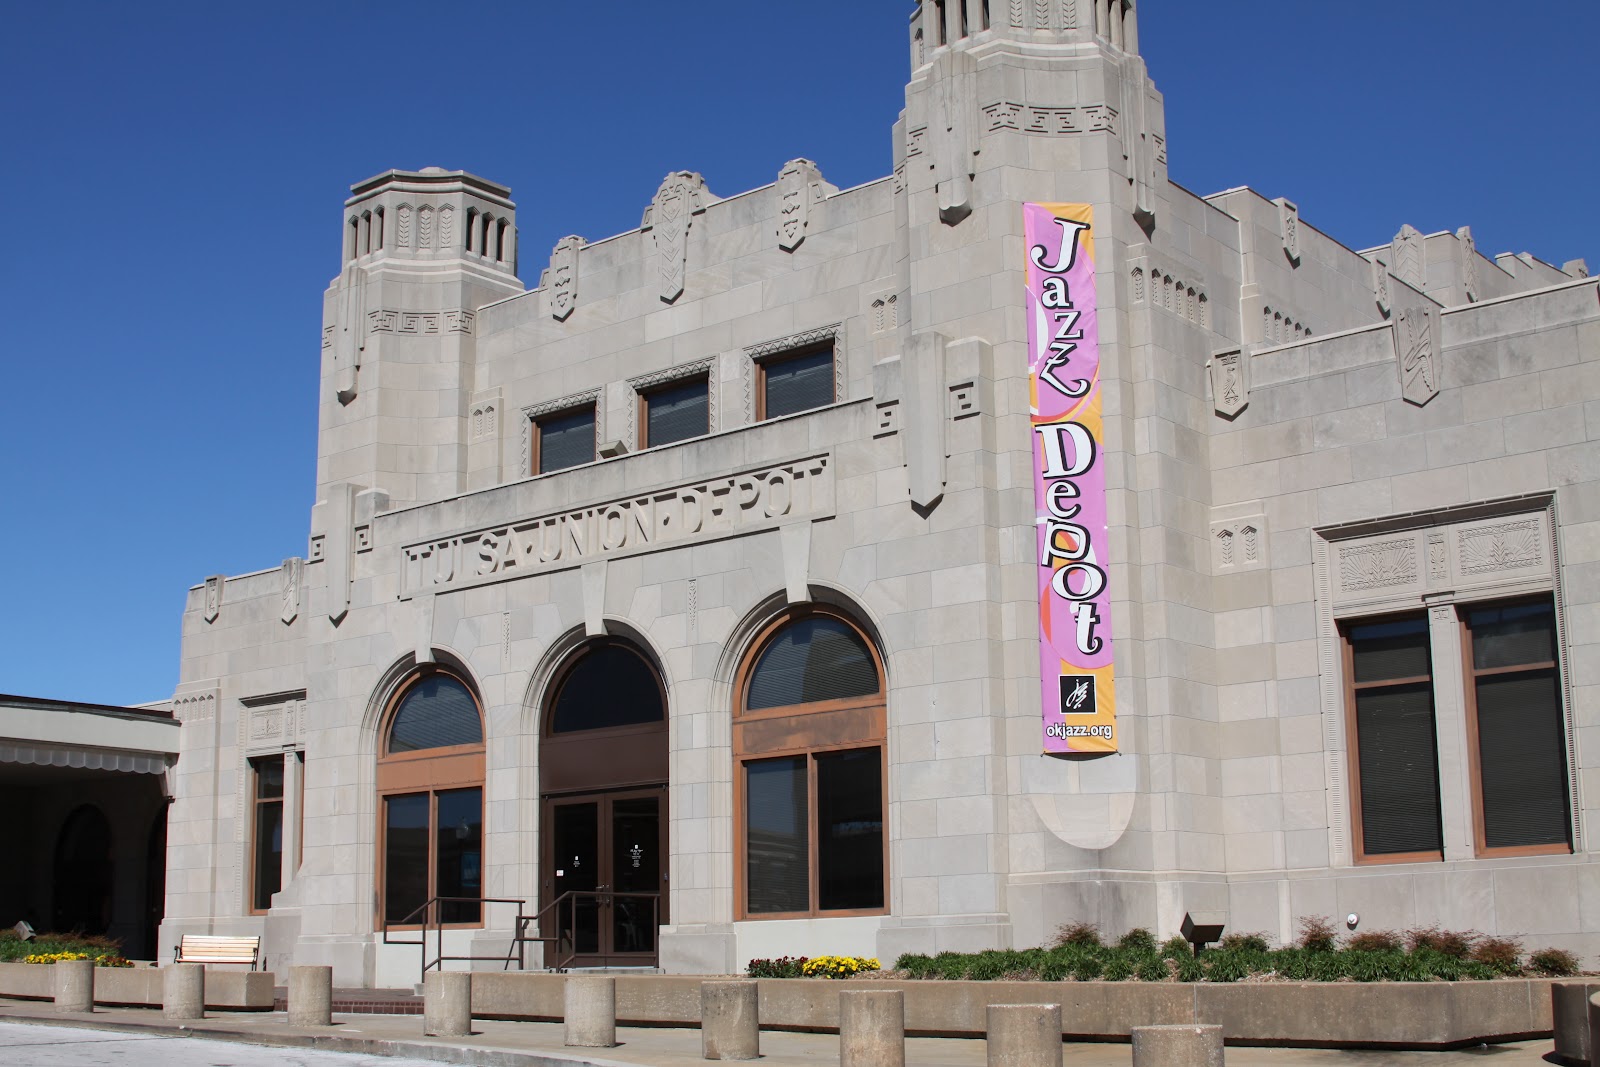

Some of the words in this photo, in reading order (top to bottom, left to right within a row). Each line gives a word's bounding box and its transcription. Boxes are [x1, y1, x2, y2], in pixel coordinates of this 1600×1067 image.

[1030, 217, 1091, 398] Jazz
[408, 528, 524, 588] TULSA
[538, 497, 656, 562] UNION
[676, 461, 826, 533] DEPOT
[1035, 421, 1107, 655] Depot
[1046, 722, 1113, 741] okjazz.org
